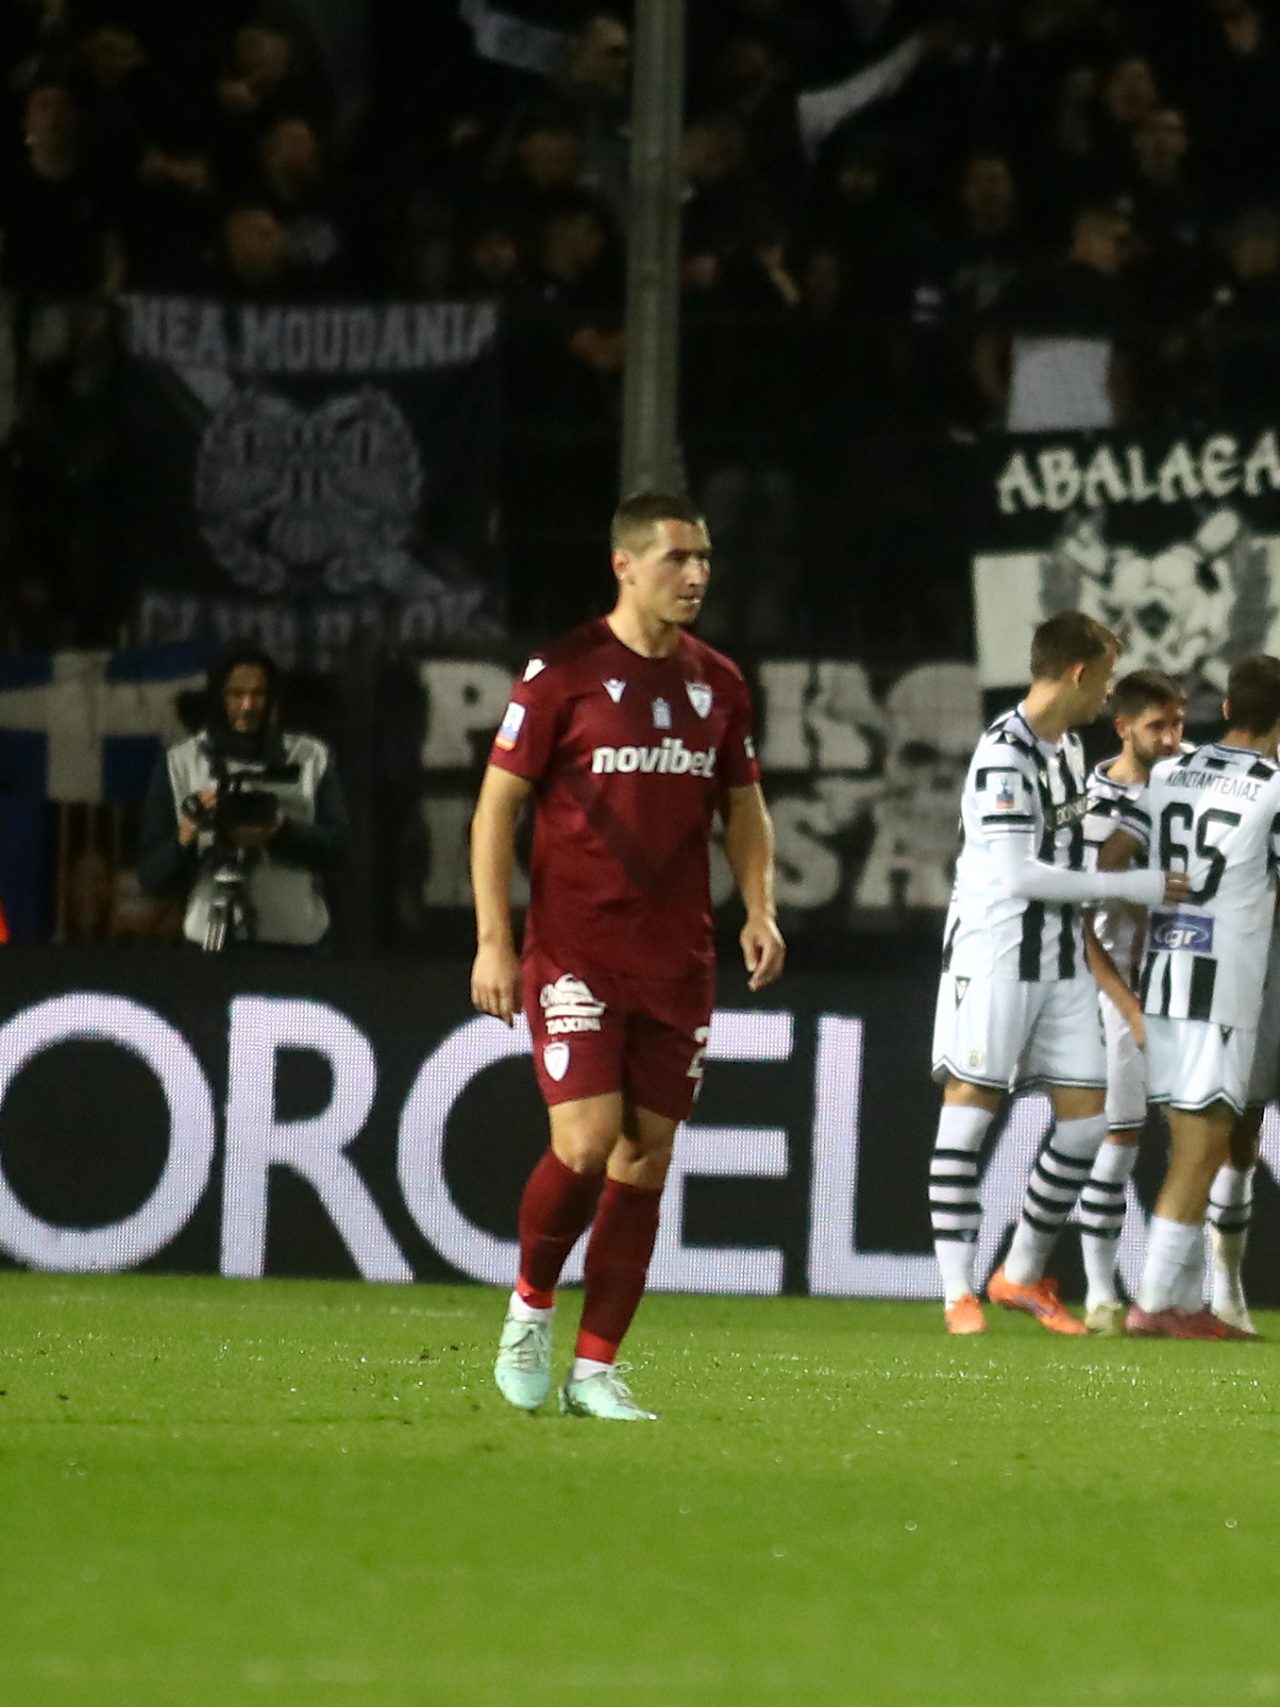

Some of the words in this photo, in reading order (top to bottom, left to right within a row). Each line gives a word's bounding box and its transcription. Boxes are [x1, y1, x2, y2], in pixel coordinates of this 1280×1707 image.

[128, 299, 228, 368] NEA
[587, 737, 716, 778] novibet
[1160, 801, 1242, 906] 65
